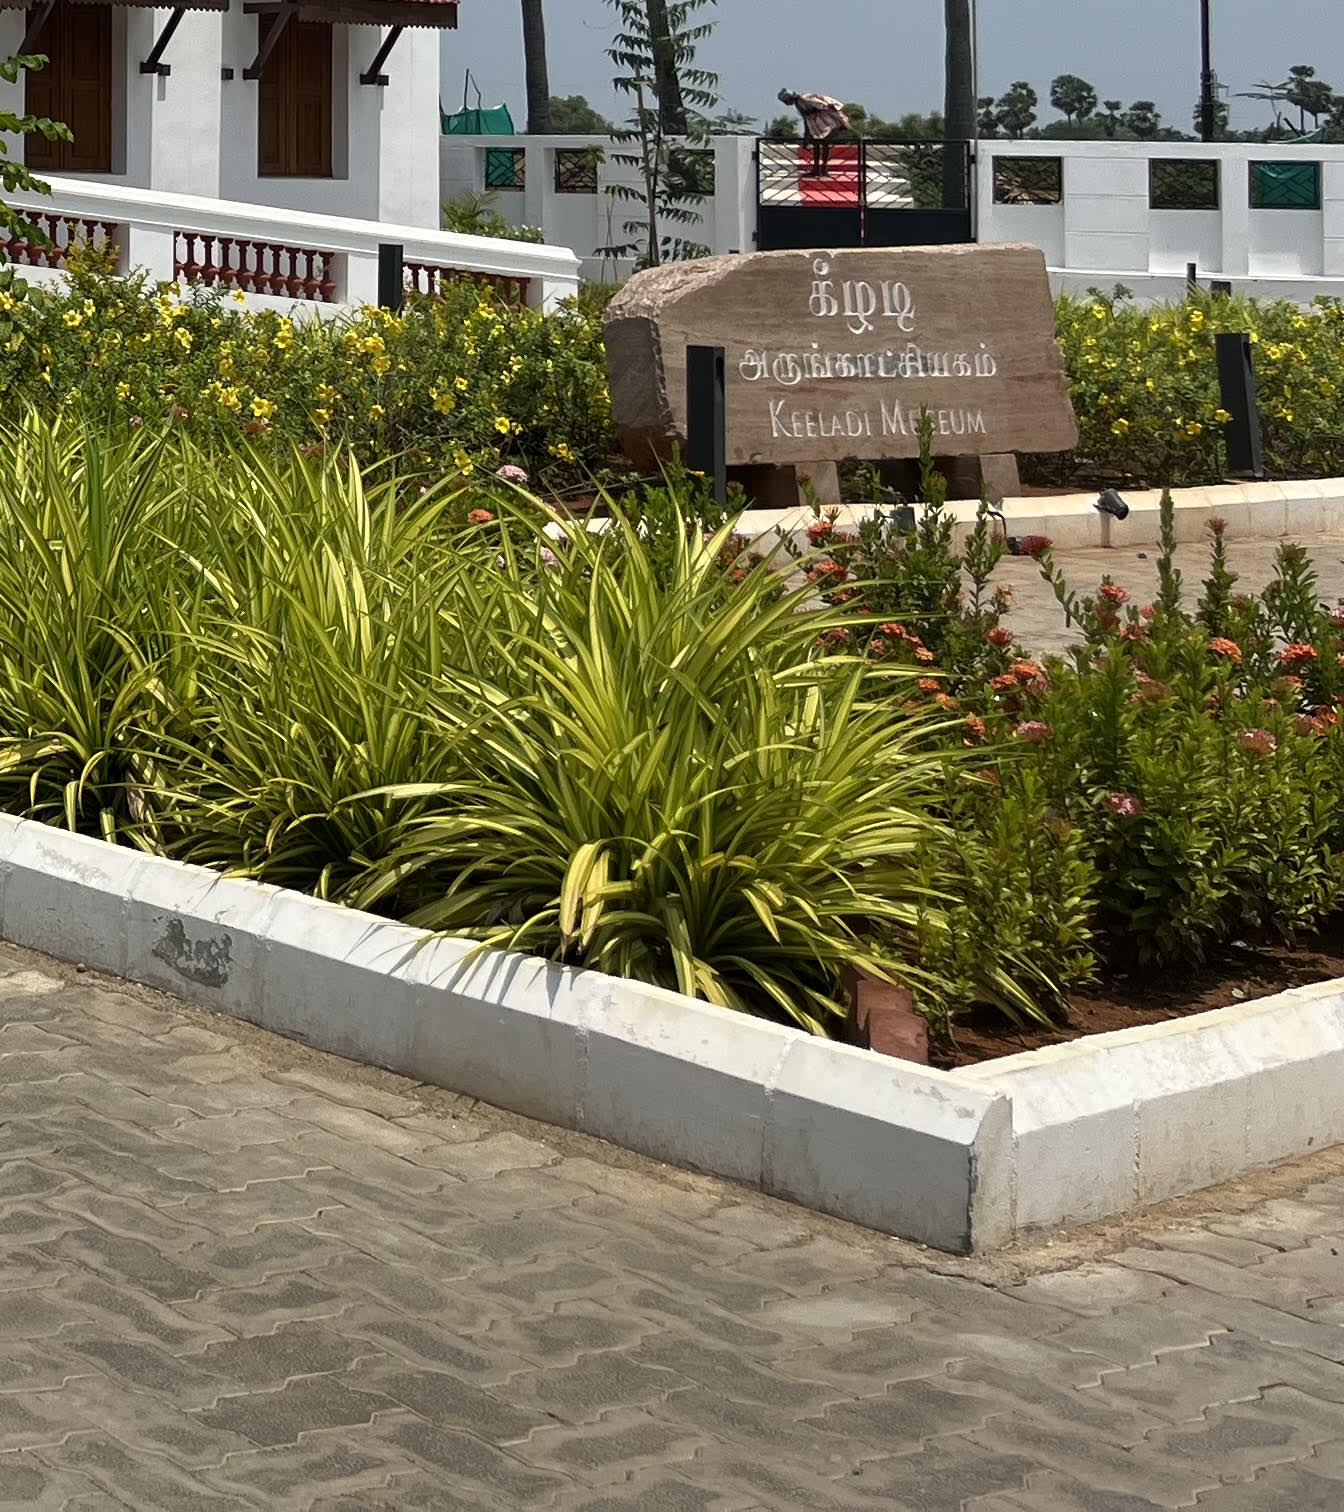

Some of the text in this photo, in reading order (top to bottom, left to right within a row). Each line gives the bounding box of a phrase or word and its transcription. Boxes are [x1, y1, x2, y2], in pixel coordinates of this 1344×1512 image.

[809, 257, 916, 335] கீழடி
[738, 342, 998, 386] அருங்காட்சியகம்
[768, 398, 872, 438] KEELADI
